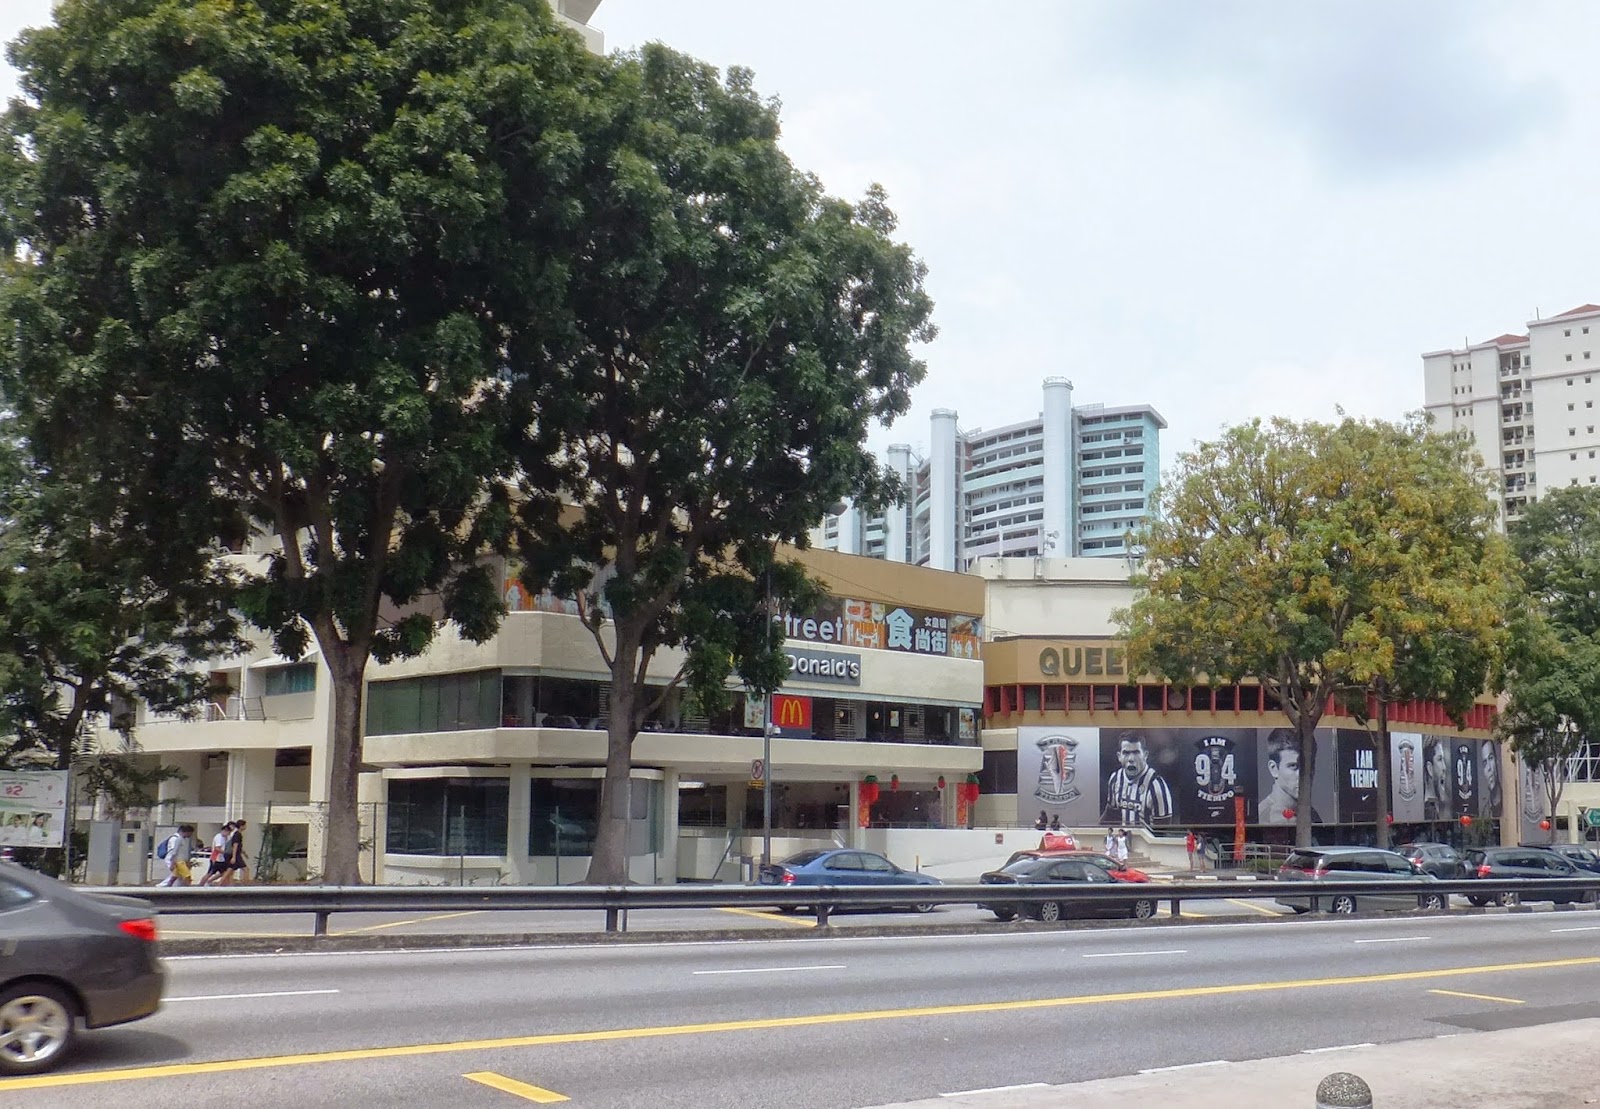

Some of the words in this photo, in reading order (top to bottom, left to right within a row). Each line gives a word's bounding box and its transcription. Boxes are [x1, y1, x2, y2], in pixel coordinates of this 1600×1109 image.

[886, 608, 914, 650] 食
[786, 654, 860, 678] Donald's
[1039, 647, 1133, 676] QUEE
[1210, 738, 1226, 747] AM
[1195, 754, 1236, 786] 94
[1360, 750, 1373, 768] AM
[1197, 790, 1234, 802] TIEMPO
